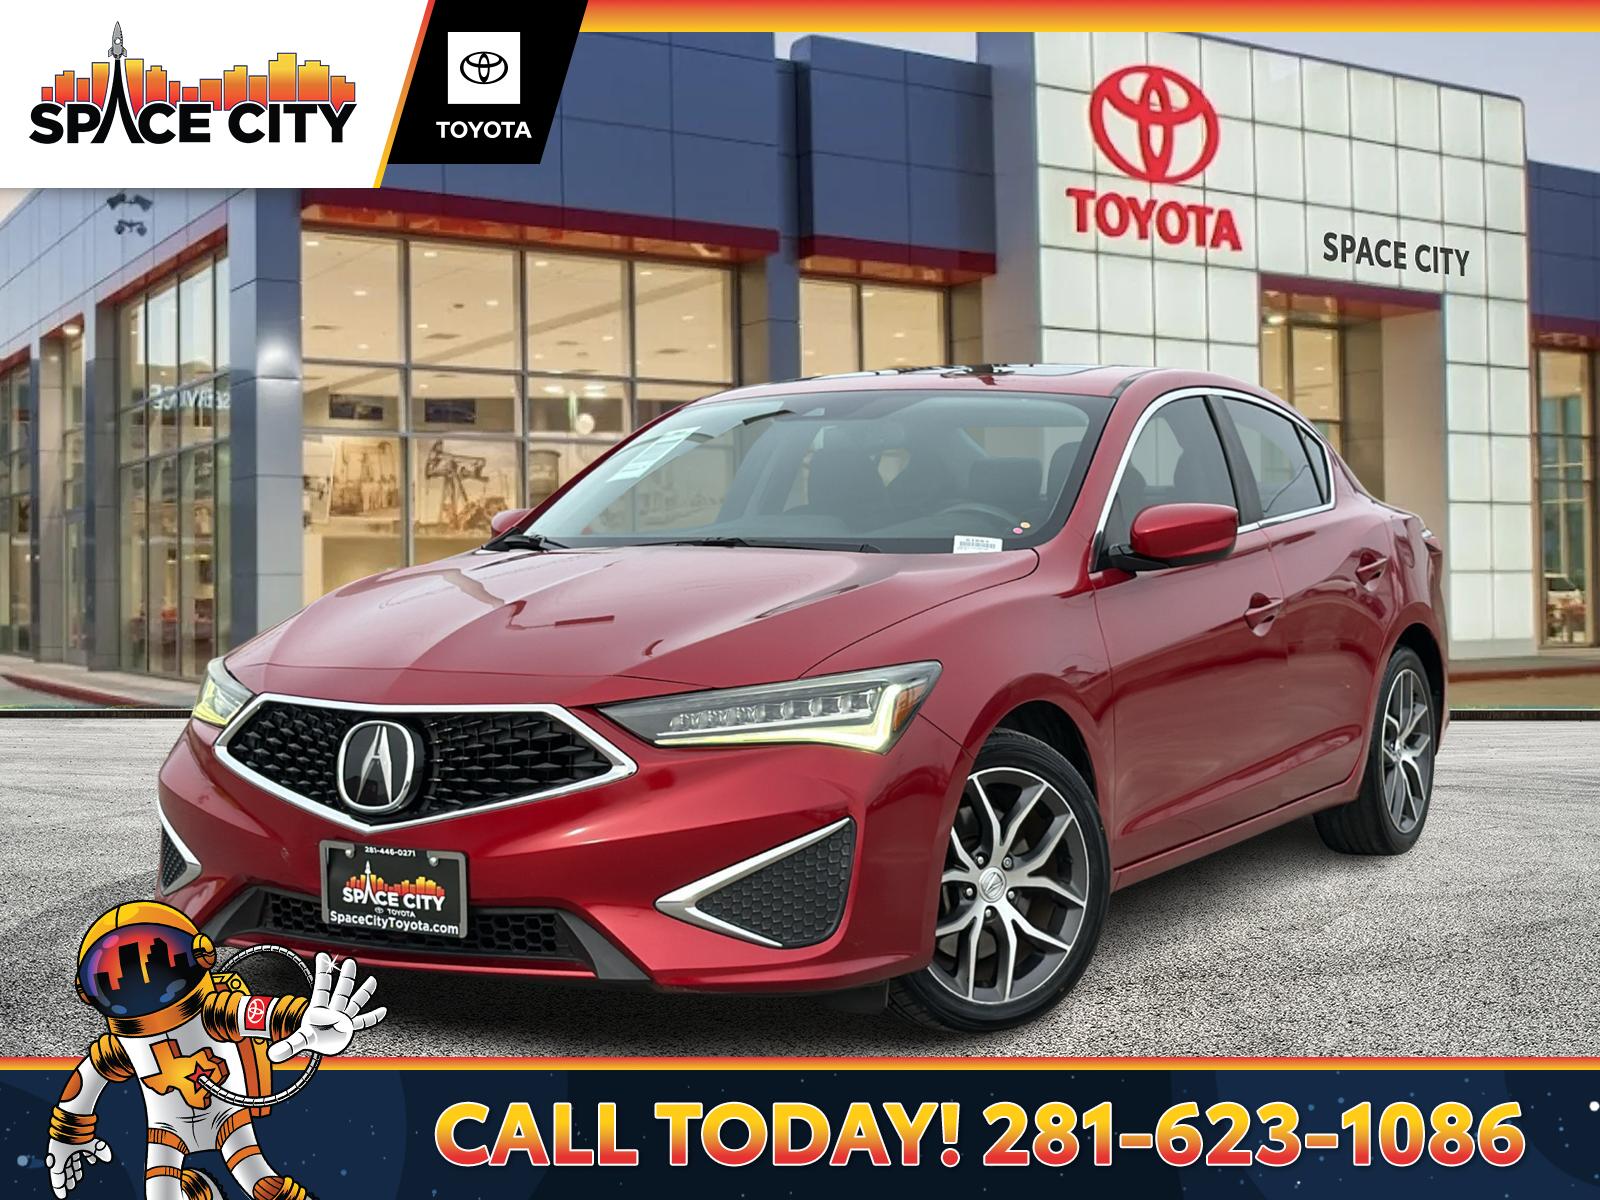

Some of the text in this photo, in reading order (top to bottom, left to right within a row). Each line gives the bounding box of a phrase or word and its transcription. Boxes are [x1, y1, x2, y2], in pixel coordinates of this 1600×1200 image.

[1066, 187, 1243, 251] TOYOTA
[1323, 232, 1470, 277] SPACE CITY
[342, 873, 446, 911] SPACE CITY
[330, 911, 459, 935] SpaceCityToyota.com
[387, 908, 416, 918] TOYOTA
